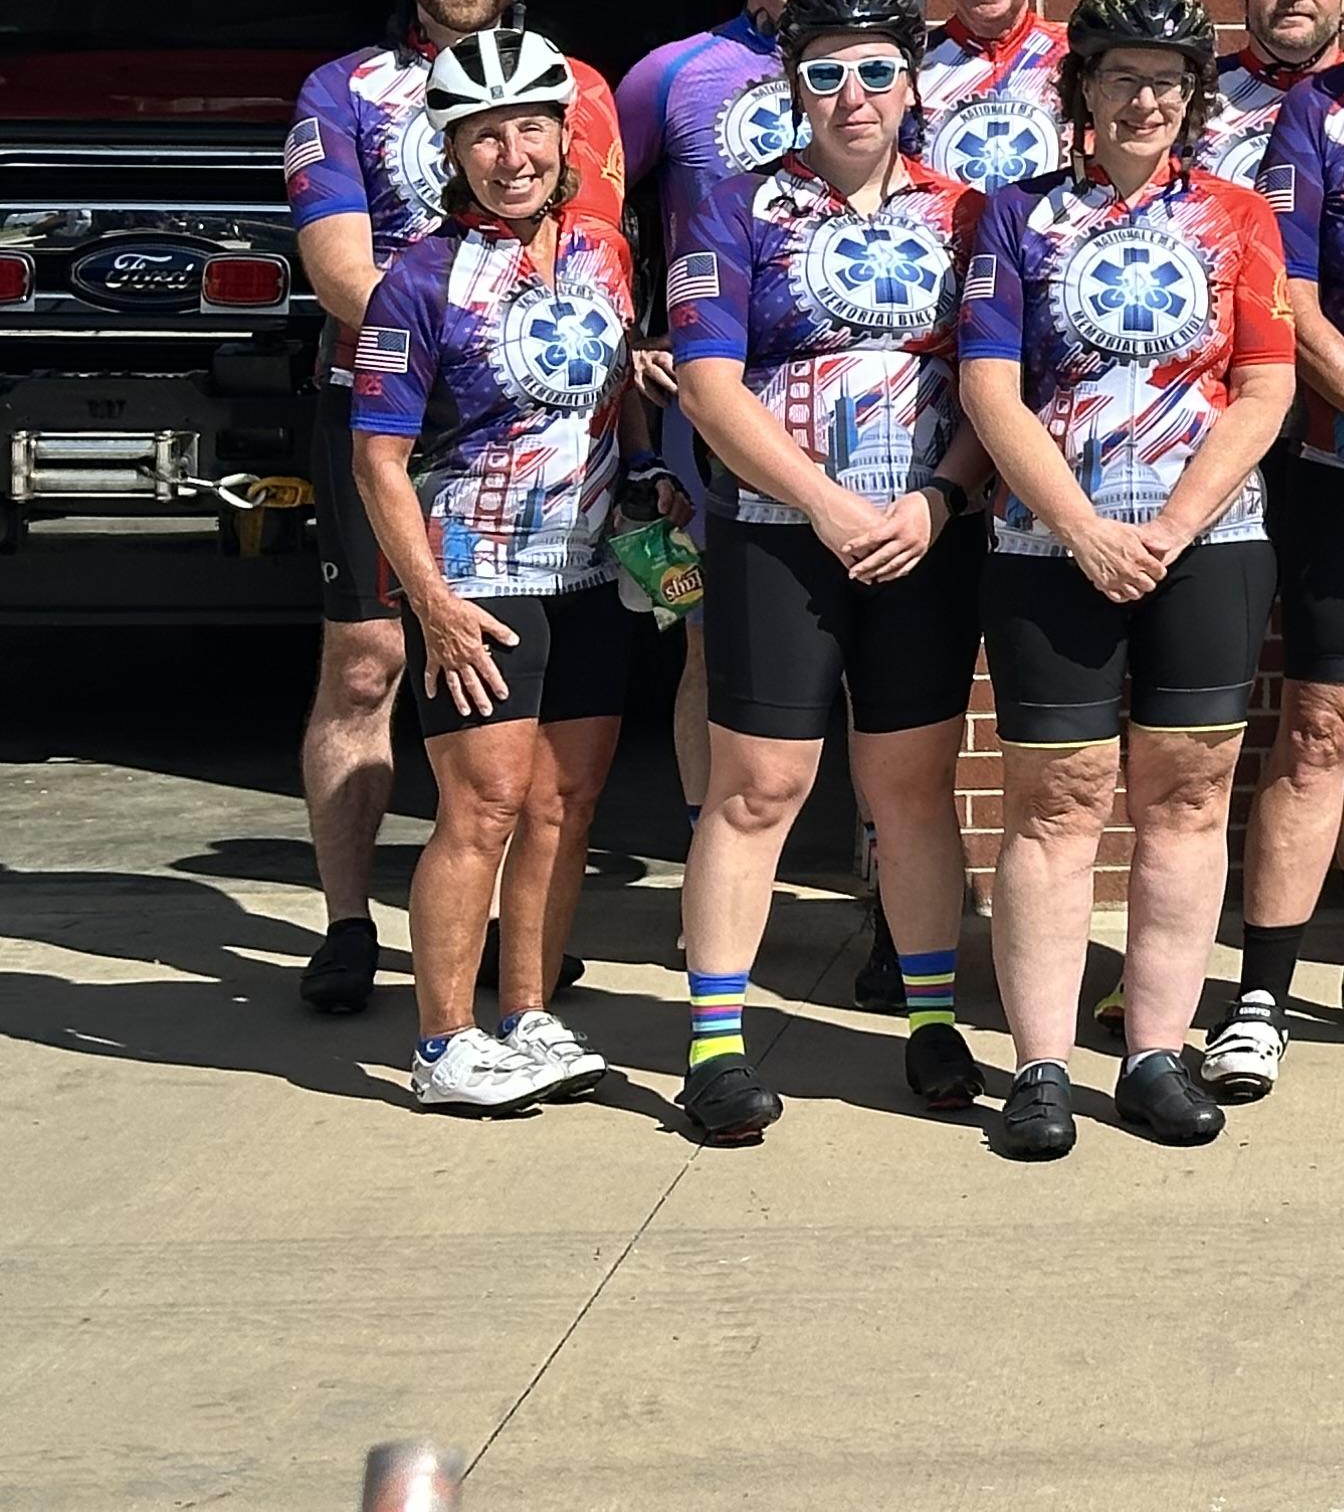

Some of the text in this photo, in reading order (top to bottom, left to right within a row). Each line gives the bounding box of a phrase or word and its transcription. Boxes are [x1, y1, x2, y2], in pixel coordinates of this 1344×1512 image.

[1093, 228, 1146, 249] NATIONAL
[104, 253, 195, 289] Ford
[816, 286, 893, 328] MEMORIAL
[899, 310, 933, 327] BIKE
[1071, 310, 1139, 355] MEMORIAL
[1143, 336, 1181, 355] BIKE
